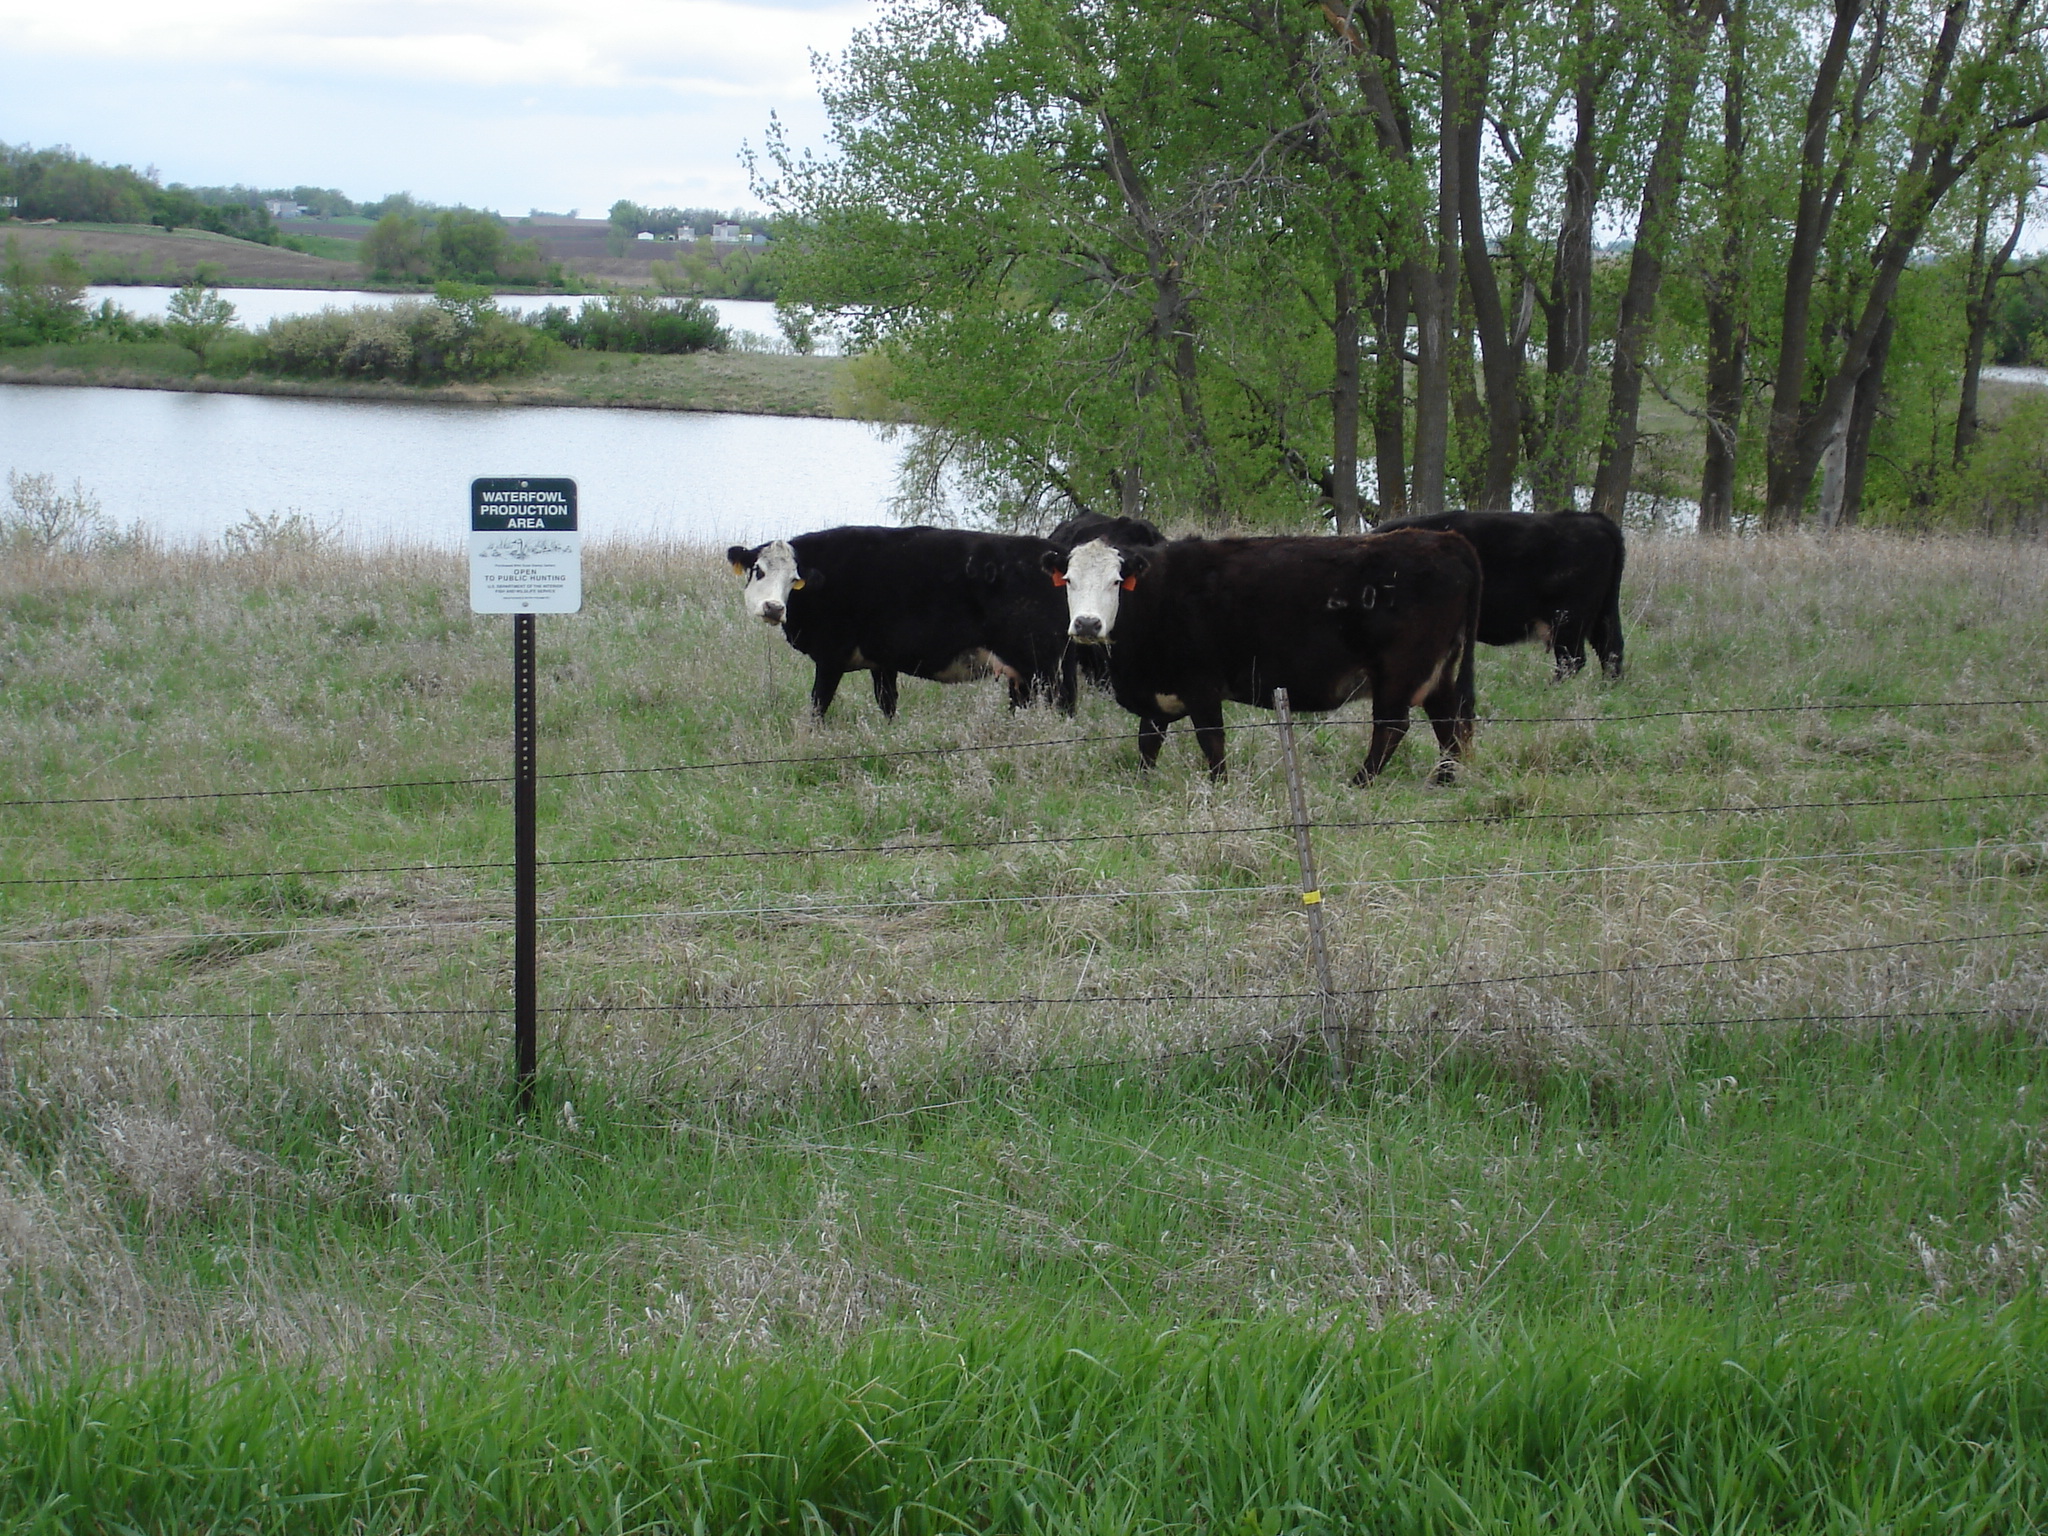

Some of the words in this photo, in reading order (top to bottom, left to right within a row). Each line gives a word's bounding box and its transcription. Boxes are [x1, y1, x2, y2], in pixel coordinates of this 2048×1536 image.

[482, 492, 566, 502] WATERFOWL
[480, 505, 568, 515] PRODUCTION
[507, 518, 545, 529] AREA
